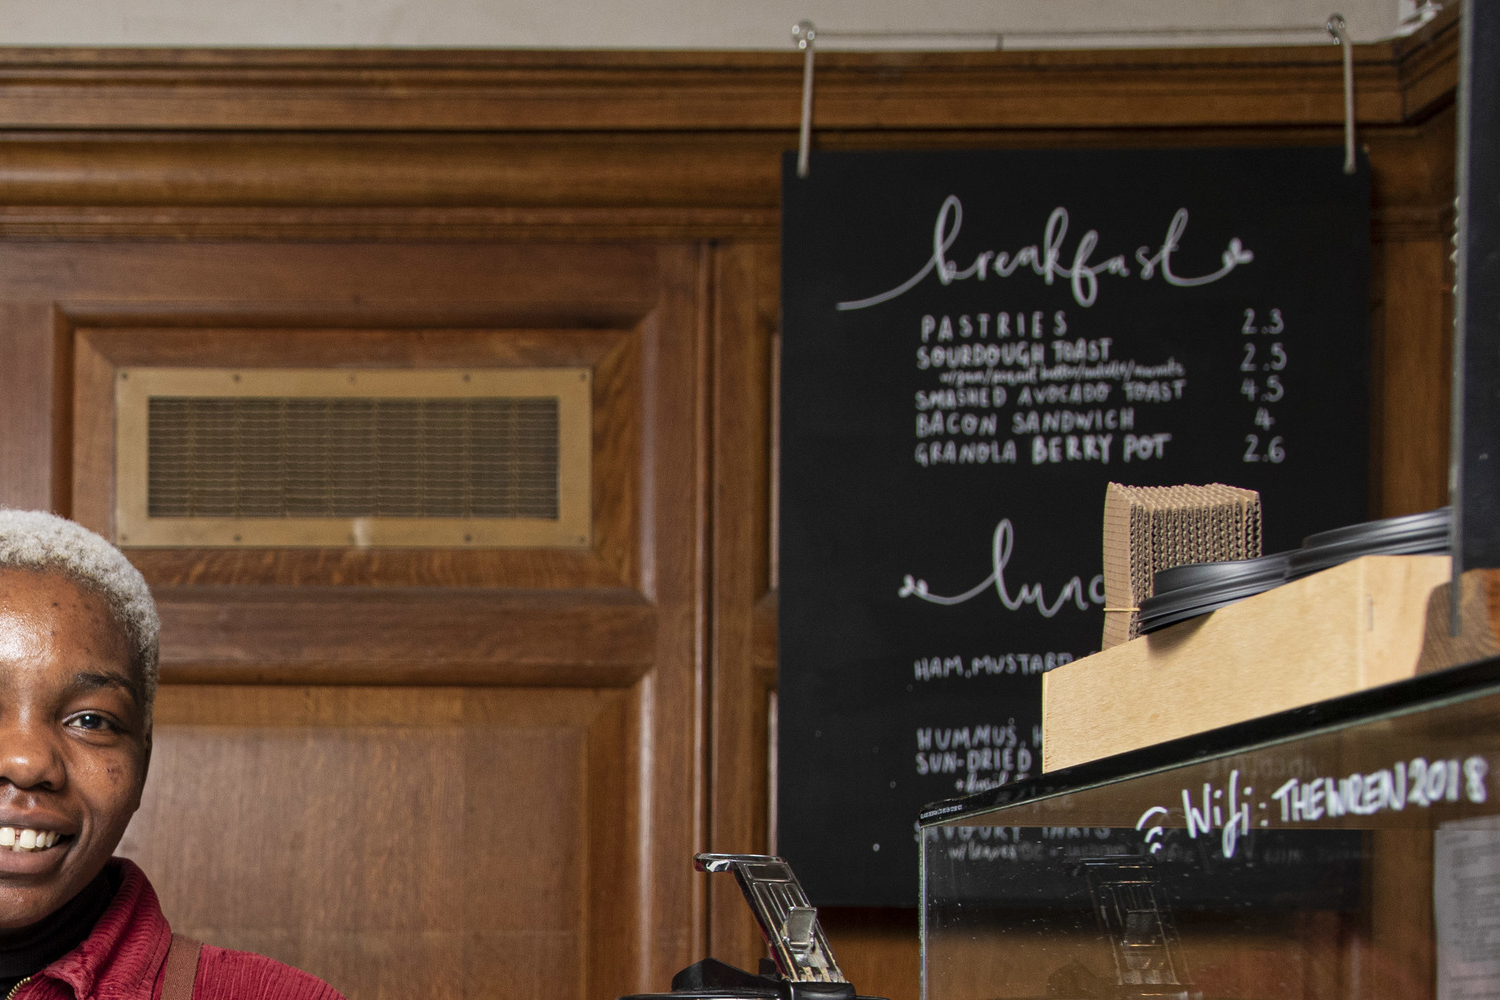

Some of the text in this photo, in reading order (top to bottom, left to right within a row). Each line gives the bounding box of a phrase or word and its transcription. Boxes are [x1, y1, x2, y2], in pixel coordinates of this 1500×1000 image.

[836, 194, 1228, 308] breakfast
[921, 307, 1285, 344] PASTRIES 2.3
[915, 337, 1288, 372] SOURDOUGH TOAST 2.5
[915, 387, 1007, 411] SMASHED
[1017, 382, 1112, 406] AVOCADO
[1123, 379, 1187, 404] TOAST
[915, 407, 1274, 438] BACON SANDWICH 4
[914, 433, 1286, 467] GRANOLA BERRY POT 2.6
[915, 747, 1033, 775] SUN-DRIED
